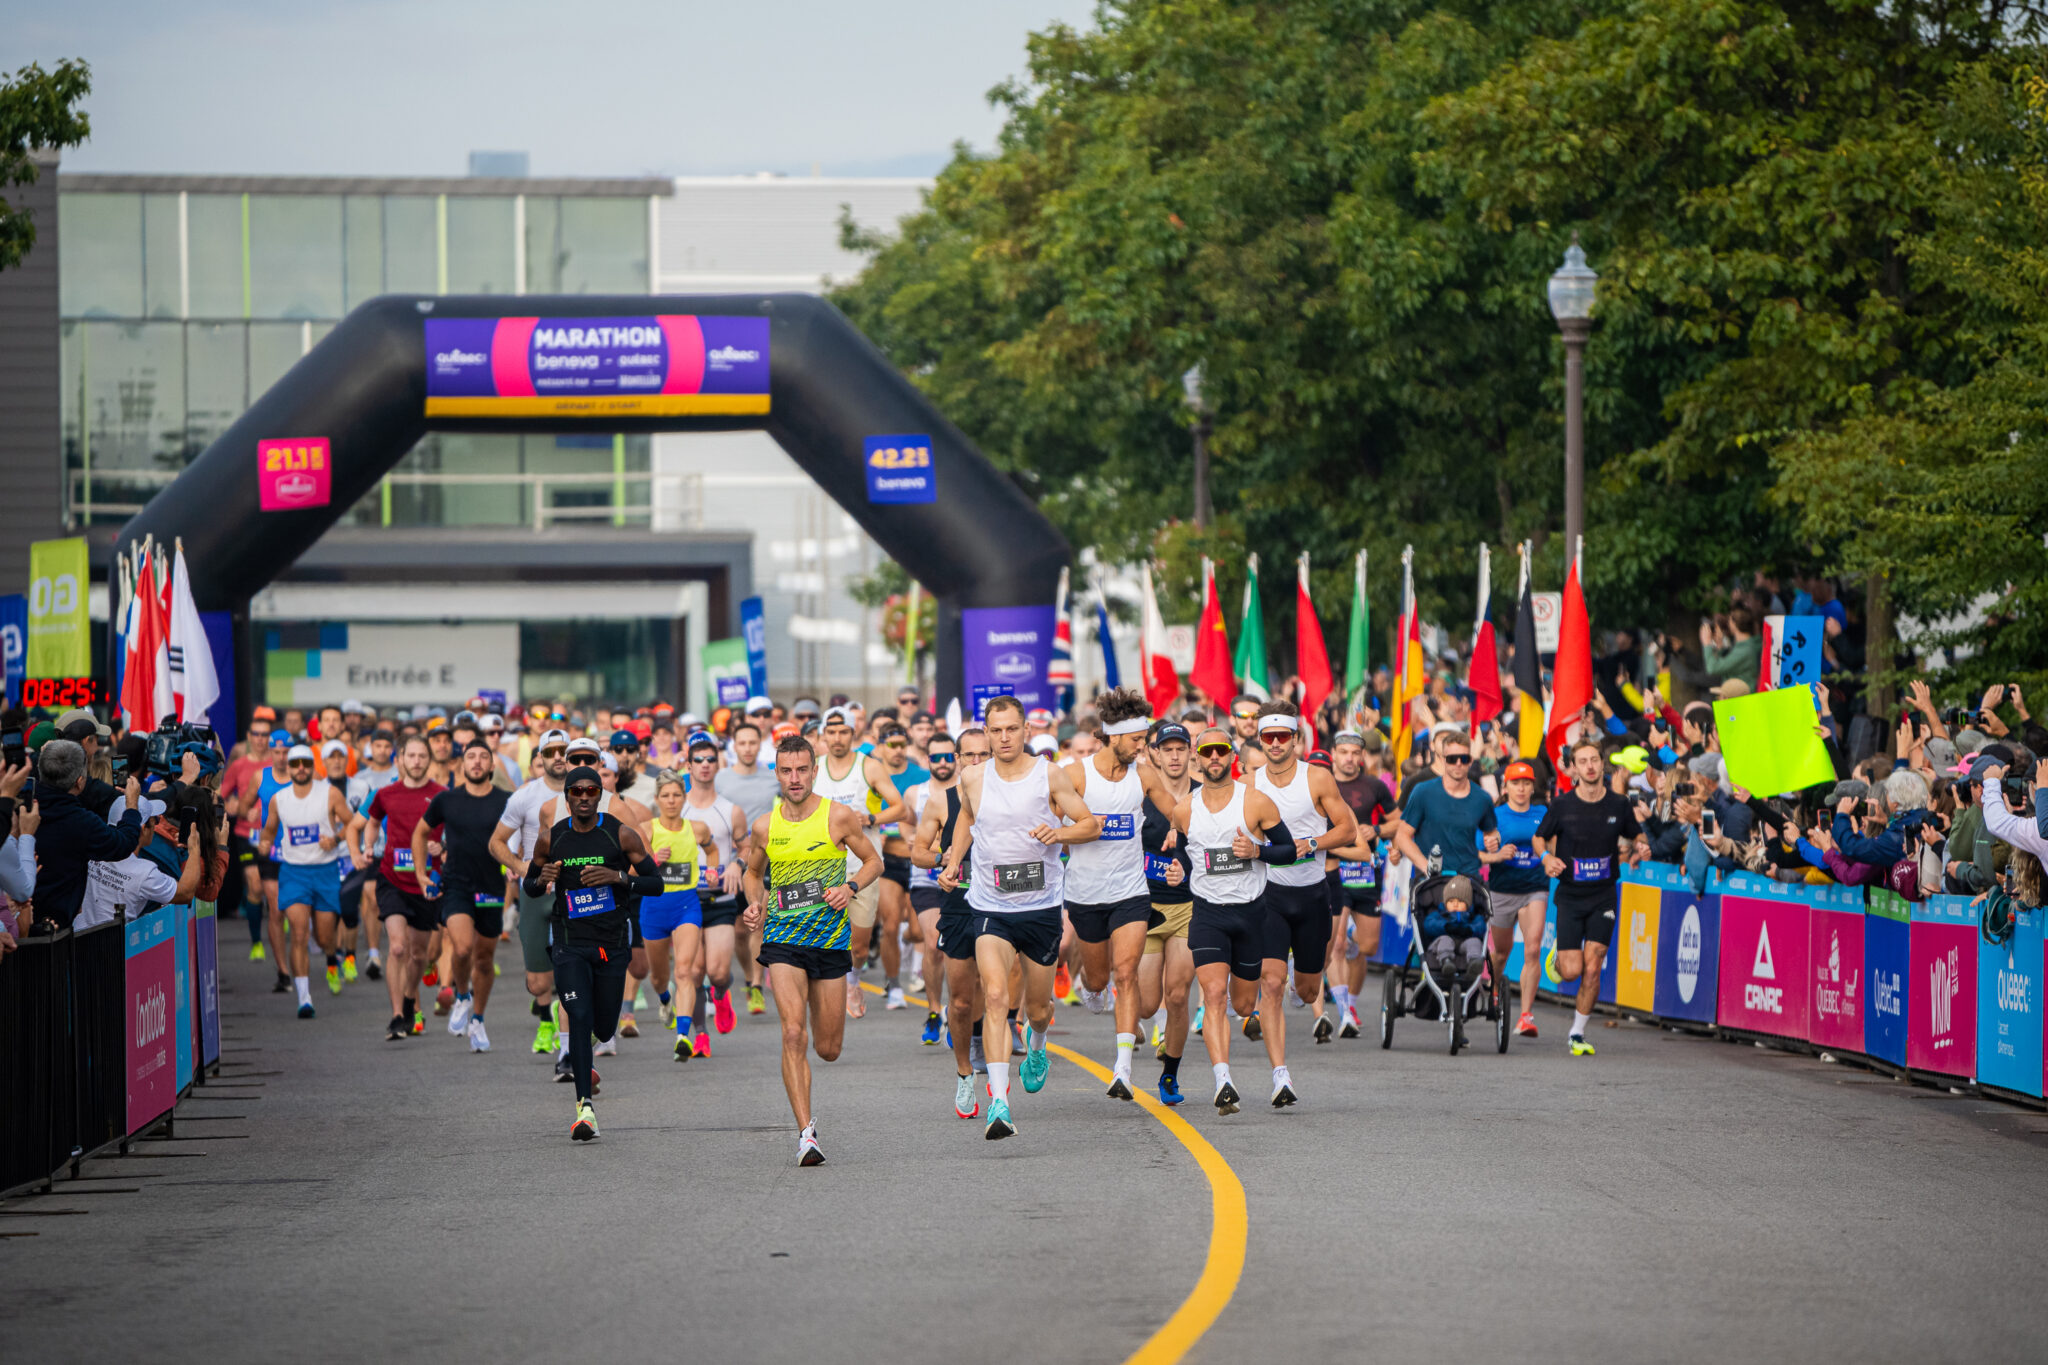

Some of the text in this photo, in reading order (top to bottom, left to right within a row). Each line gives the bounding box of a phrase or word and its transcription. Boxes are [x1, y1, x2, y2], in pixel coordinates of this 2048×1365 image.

[535, 327, 661, 349] MARATHON
[536, 353, 599, 369] beneva
[348, 664, 456, 685] Entrée E
[564, 856, 604, 867] KARPOS
[1216, 853, 1229, 862] 26
[1213, 863, 1244, 871] GUILLAUME
[1006, 870, 1019, 879] 27
[574, 894, 593, 905] 683
[787, 890, 799, 900] 23
[789, 900, 814, 910] ANTHONY
[1745, 984, 1783, 1015] CANAC
